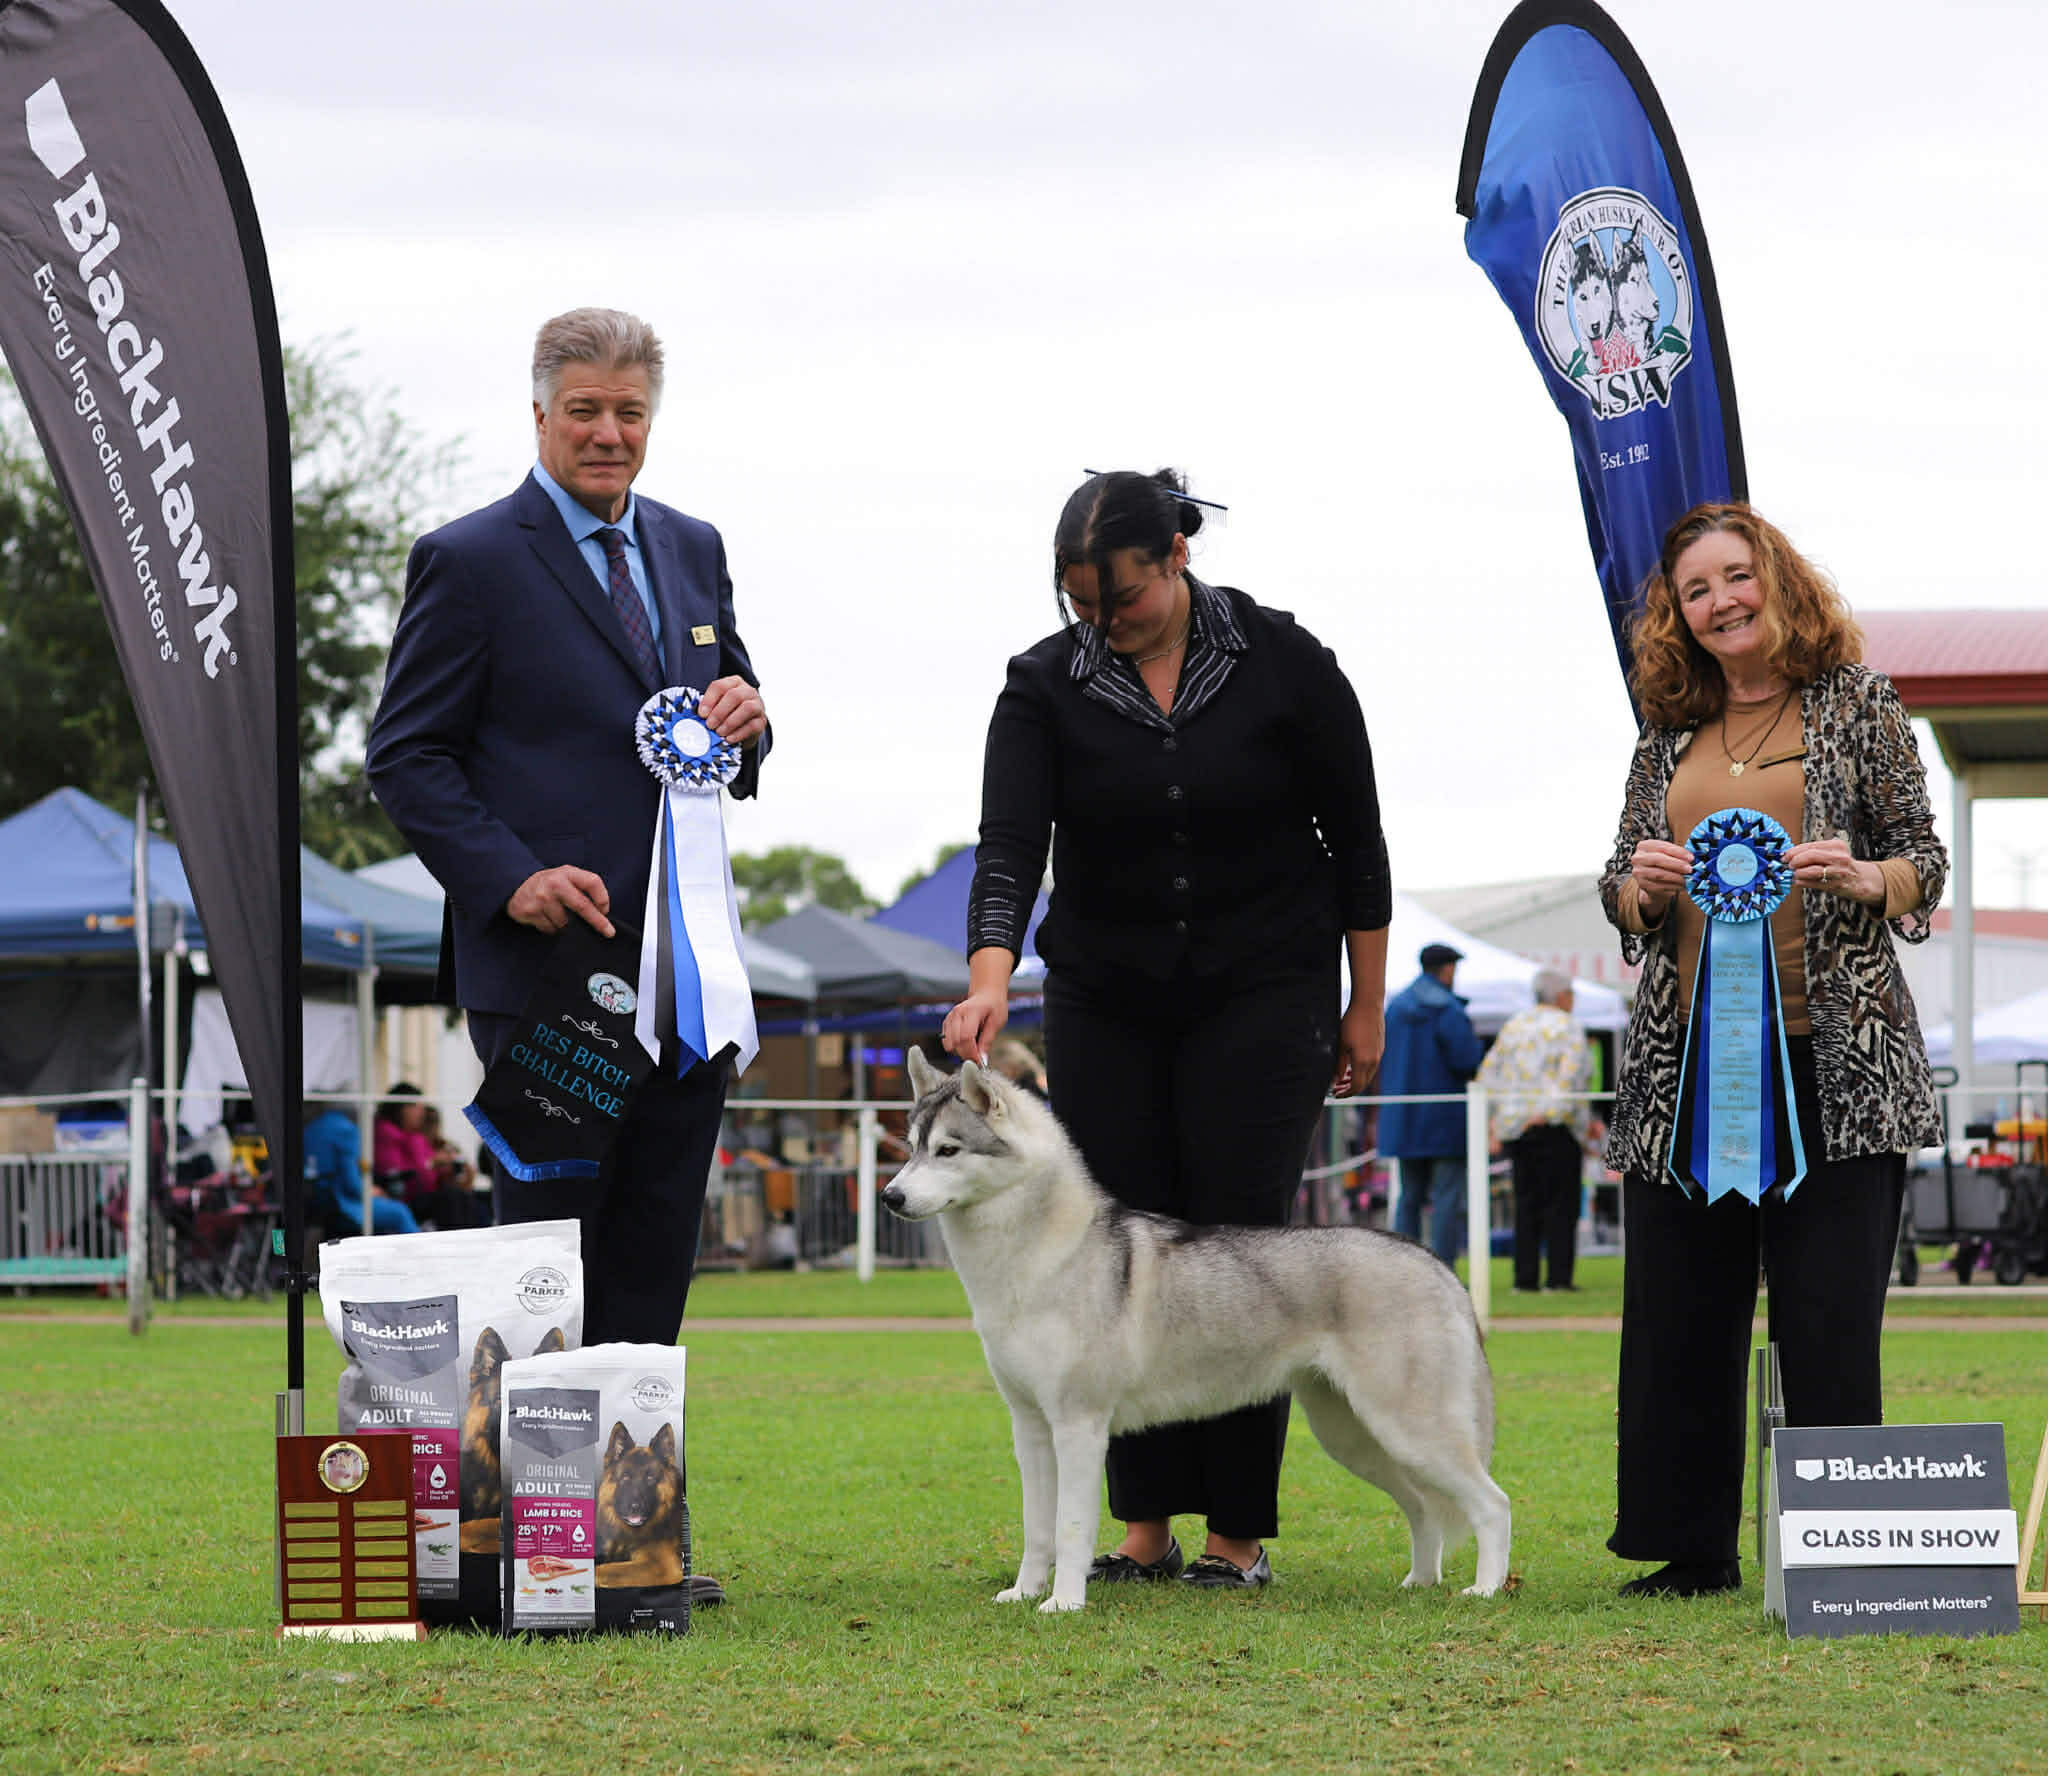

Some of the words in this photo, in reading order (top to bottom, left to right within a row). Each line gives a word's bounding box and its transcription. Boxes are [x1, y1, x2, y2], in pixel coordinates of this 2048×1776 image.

[1598, 206, 1636, 225] HUSKY
[33, 262, 74, 361] Every
[69, 355, 135, 527] Ingredient
[1600, 452, 1625, 471] Est.
[531, 1023, 572, 1055] RES
[572, 1046, 631, 1091] BITCH
[511, 1044, 624, 1118] CHALLENGE
[524, 1285, 566, 1297] PARKES
[351, 1319, 449, 1341] BlackHawk
[370, 1384, 438, 1406] ORIGINAL
[360, 1408, 414, 1424] ADULT
[515, 1405, 592, 1422] BlackHawk
[412, 1443, 443, 1456] RICE
[526, 1463, 580, 1479] ORIGINAL
[514, 1481, 561, 1495] ADULT
[523, 1508, 549, 1518] LAMB
[560, 1508, 583, 1519] RICE
[517, 1523, 538, 1536] 25%
[542, 1523, 562, 1537] 17%
[1802, 1529, 1882, 1549] CLASS
[1889, 1529, 1913, 1549] IN
[1920, 1529, 2001, 1549] SHOW
[1812, 1600, 1853, 1616] Every
[1856, 1597, 1930, 1615] Ingredient
